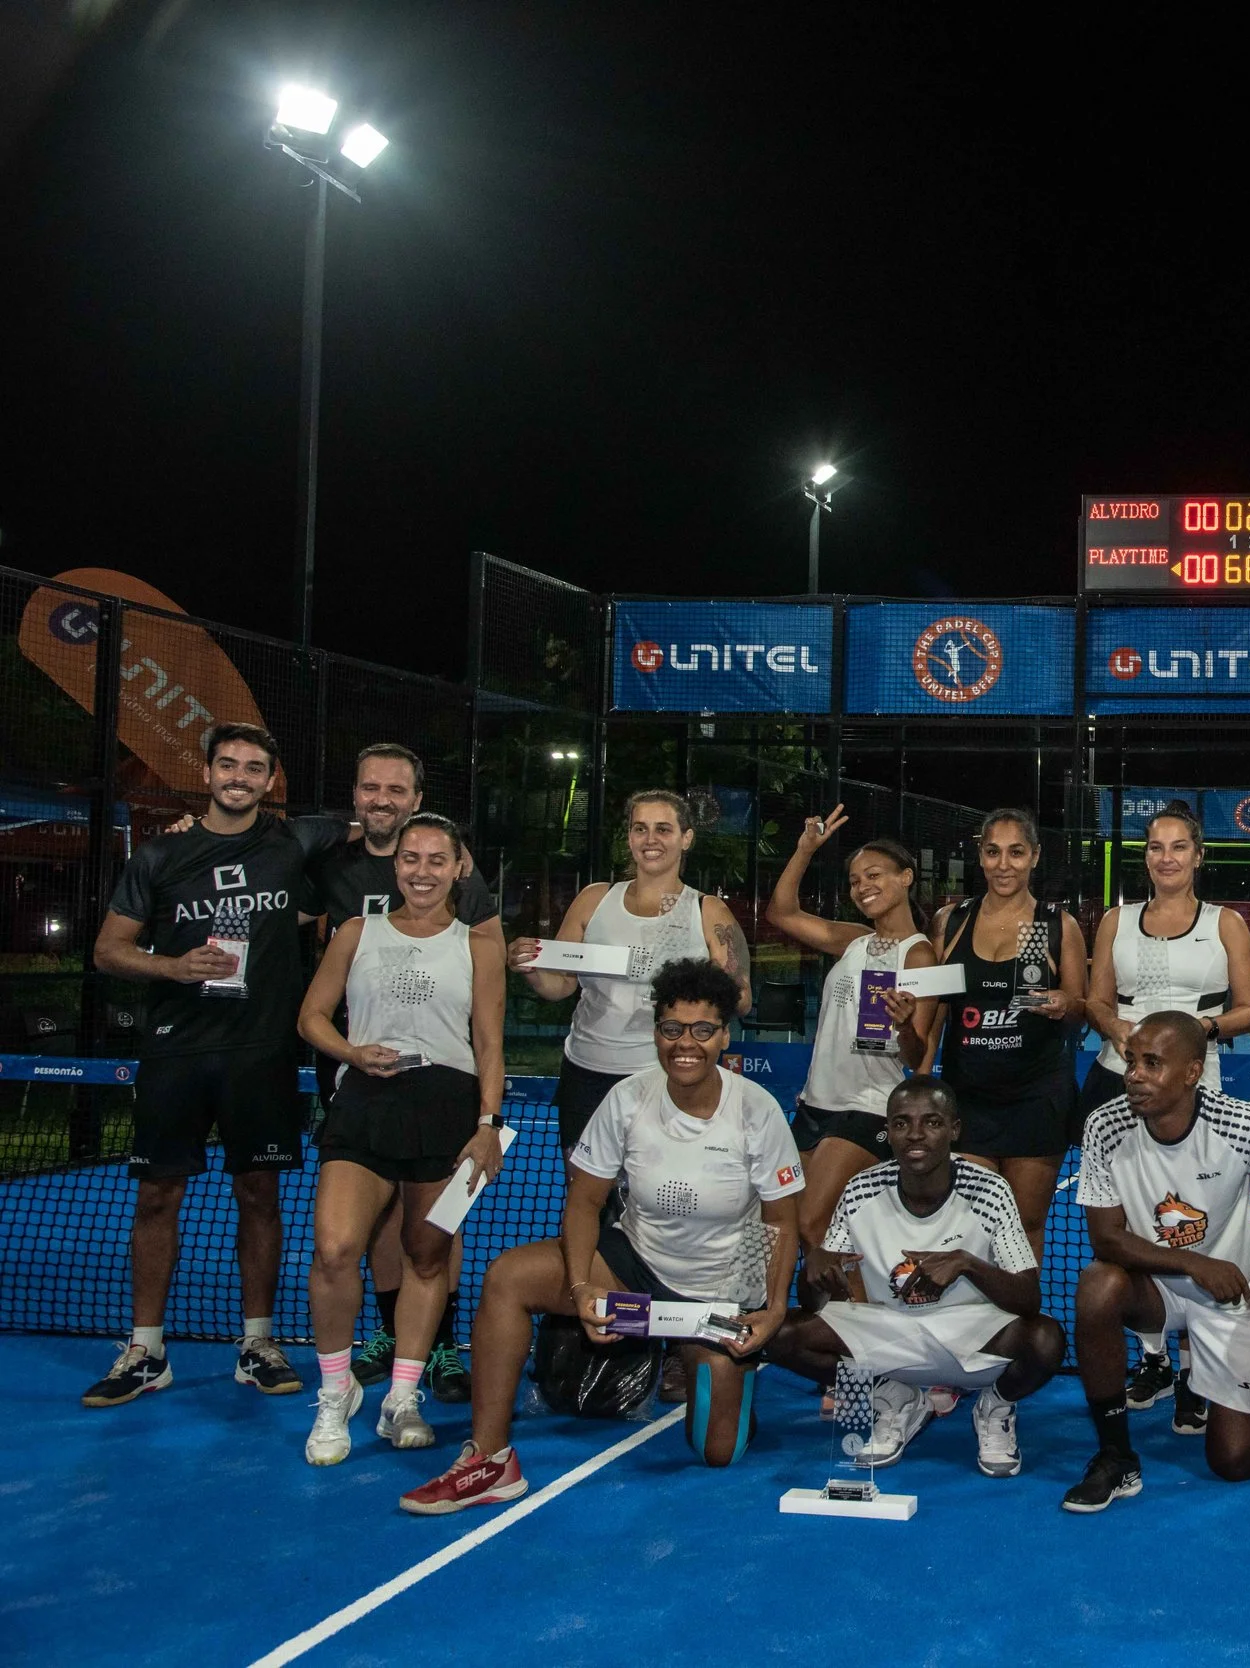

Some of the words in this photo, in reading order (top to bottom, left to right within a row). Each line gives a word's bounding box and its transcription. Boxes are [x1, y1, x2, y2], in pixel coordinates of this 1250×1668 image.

[1090, 503, 1159, 519] ALVIDRO
[1184, 502, 1218, 531] 00
[1089, 548, 1168, 565] PLAYTIME
[1184, 555, 1218, 583] 00
[917, 632, 934, 657] THE
[936, 620, 979, 634] PADEL
[982, 633, 999, 658] CUP
[670, 644, 818, 673] UNITEL
[121, 638, 216, 751] UNIT
[922, 675, 967, 700] UNITEL
[176, 890, 288, 923] ALVIDRO
[969, 1035, 1023, 1046] BROADCOM
[34, 1066, 83, 1077] DESKONTÃO
[743, 1058, 772, 1073] BFA
[252, 1152, 293, 1163] ALVIDRO
